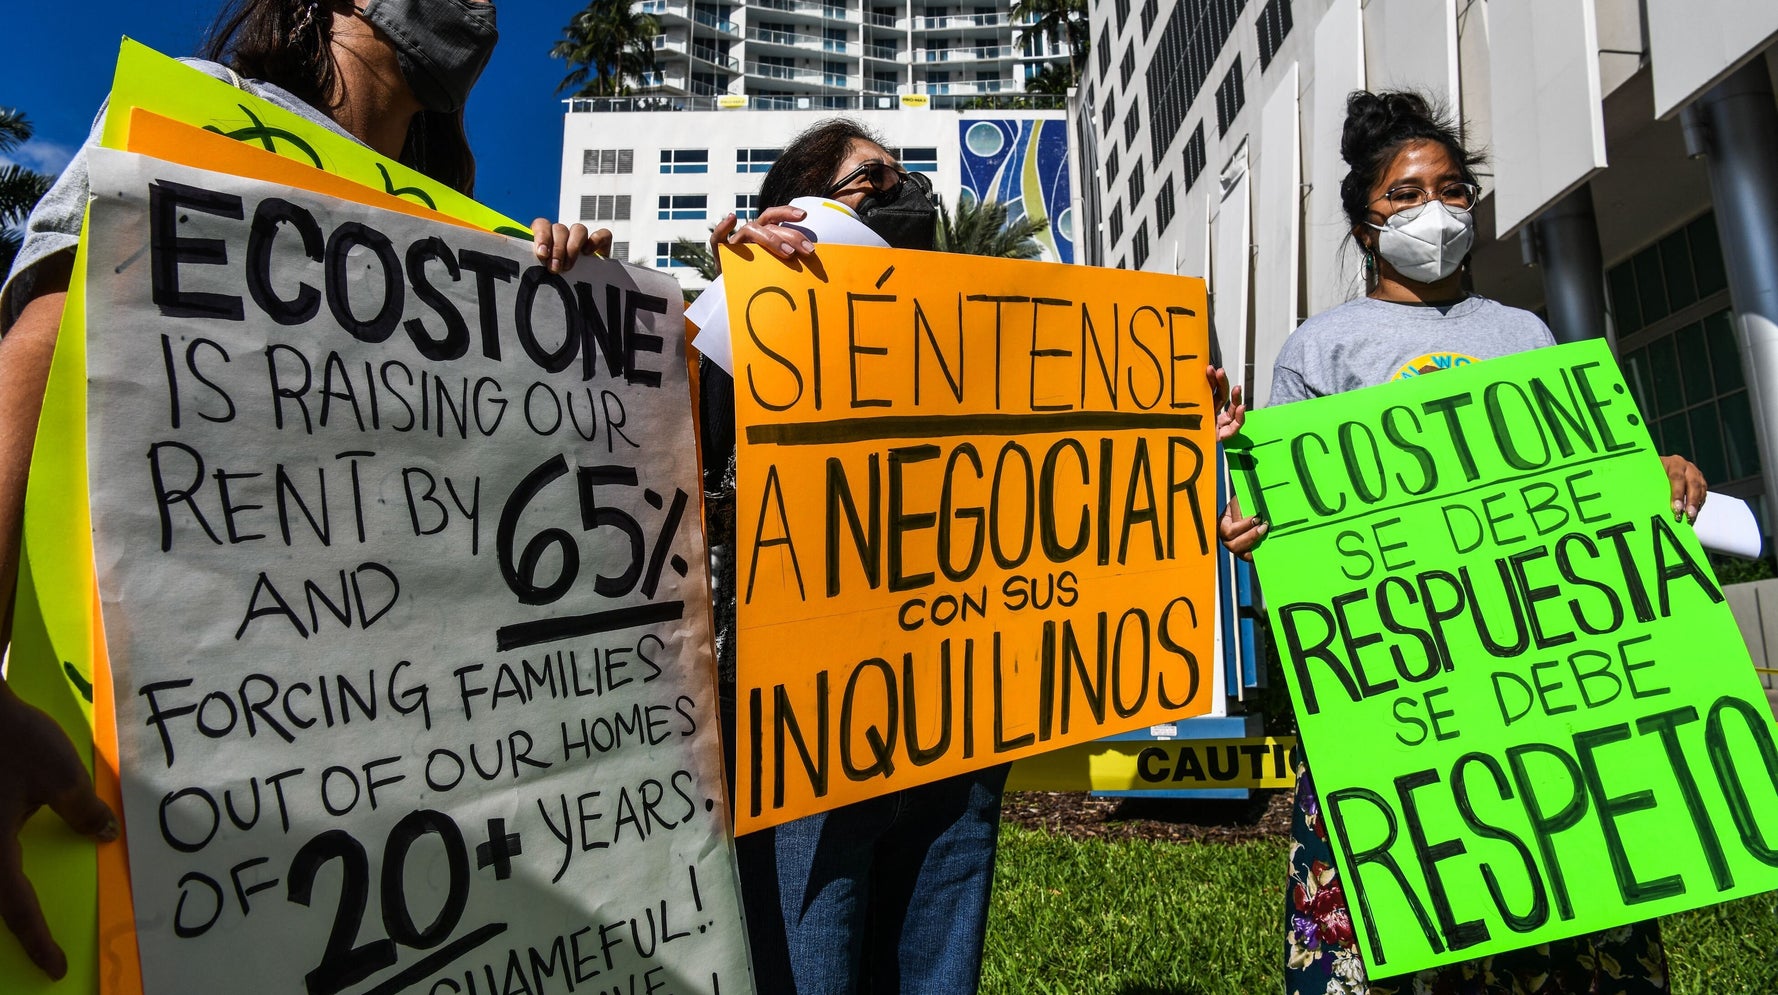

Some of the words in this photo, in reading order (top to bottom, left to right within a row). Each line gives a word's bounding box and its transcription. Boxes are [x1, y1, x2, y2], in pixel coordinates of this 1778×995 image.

[149, 178, 668, 388] ECOSTONE
[745, 265, 1200, 412] SIÉNTENSE
[160, 333, 237, 429] IS
[265, 343, 508, 440] RAISING
[523, 380, 641, 453] OUR
[1237, 360, 1640, 533] ECOSTONE:
[147, 441, 377, 552] RENT
[402, 466, 481, 556] BY
[496, 452, 689, 607] 65%
[234, 560, 400, 641] AND
[745, 464, 806, 605] A
[825, 436, 1210, 597] NEGOCIAR
[898, 585, 988, 632] CON
[1002, 570, 1079, 610] SUS
[1335, 517, 1416, 581] SE
[1441, 469, 1612, 555] DEBE
[1277, 515, 1725, 715] RESPUESTA
[1392, 686, 1461, 746] SE
[1491, 634, 1671, 727] DEBE
[138, 660, 432, 768] FORCING
[453, 633, 666, 721] FAMILIES
[157, 767, 305, 852] OUT
[320, 755, 406, 816] OF
[424, 729, 552, 792] OUR
[560, 694, 698, 763] HOMES
[749, 596, 1200, 818] INQUILINOS
[173, 855, 280, 939] OF
[287, 809, 523, 995] 20+
[536, 769, 715, 885] YEARS.
[1326, 695, 1778, 966] RESPETO
